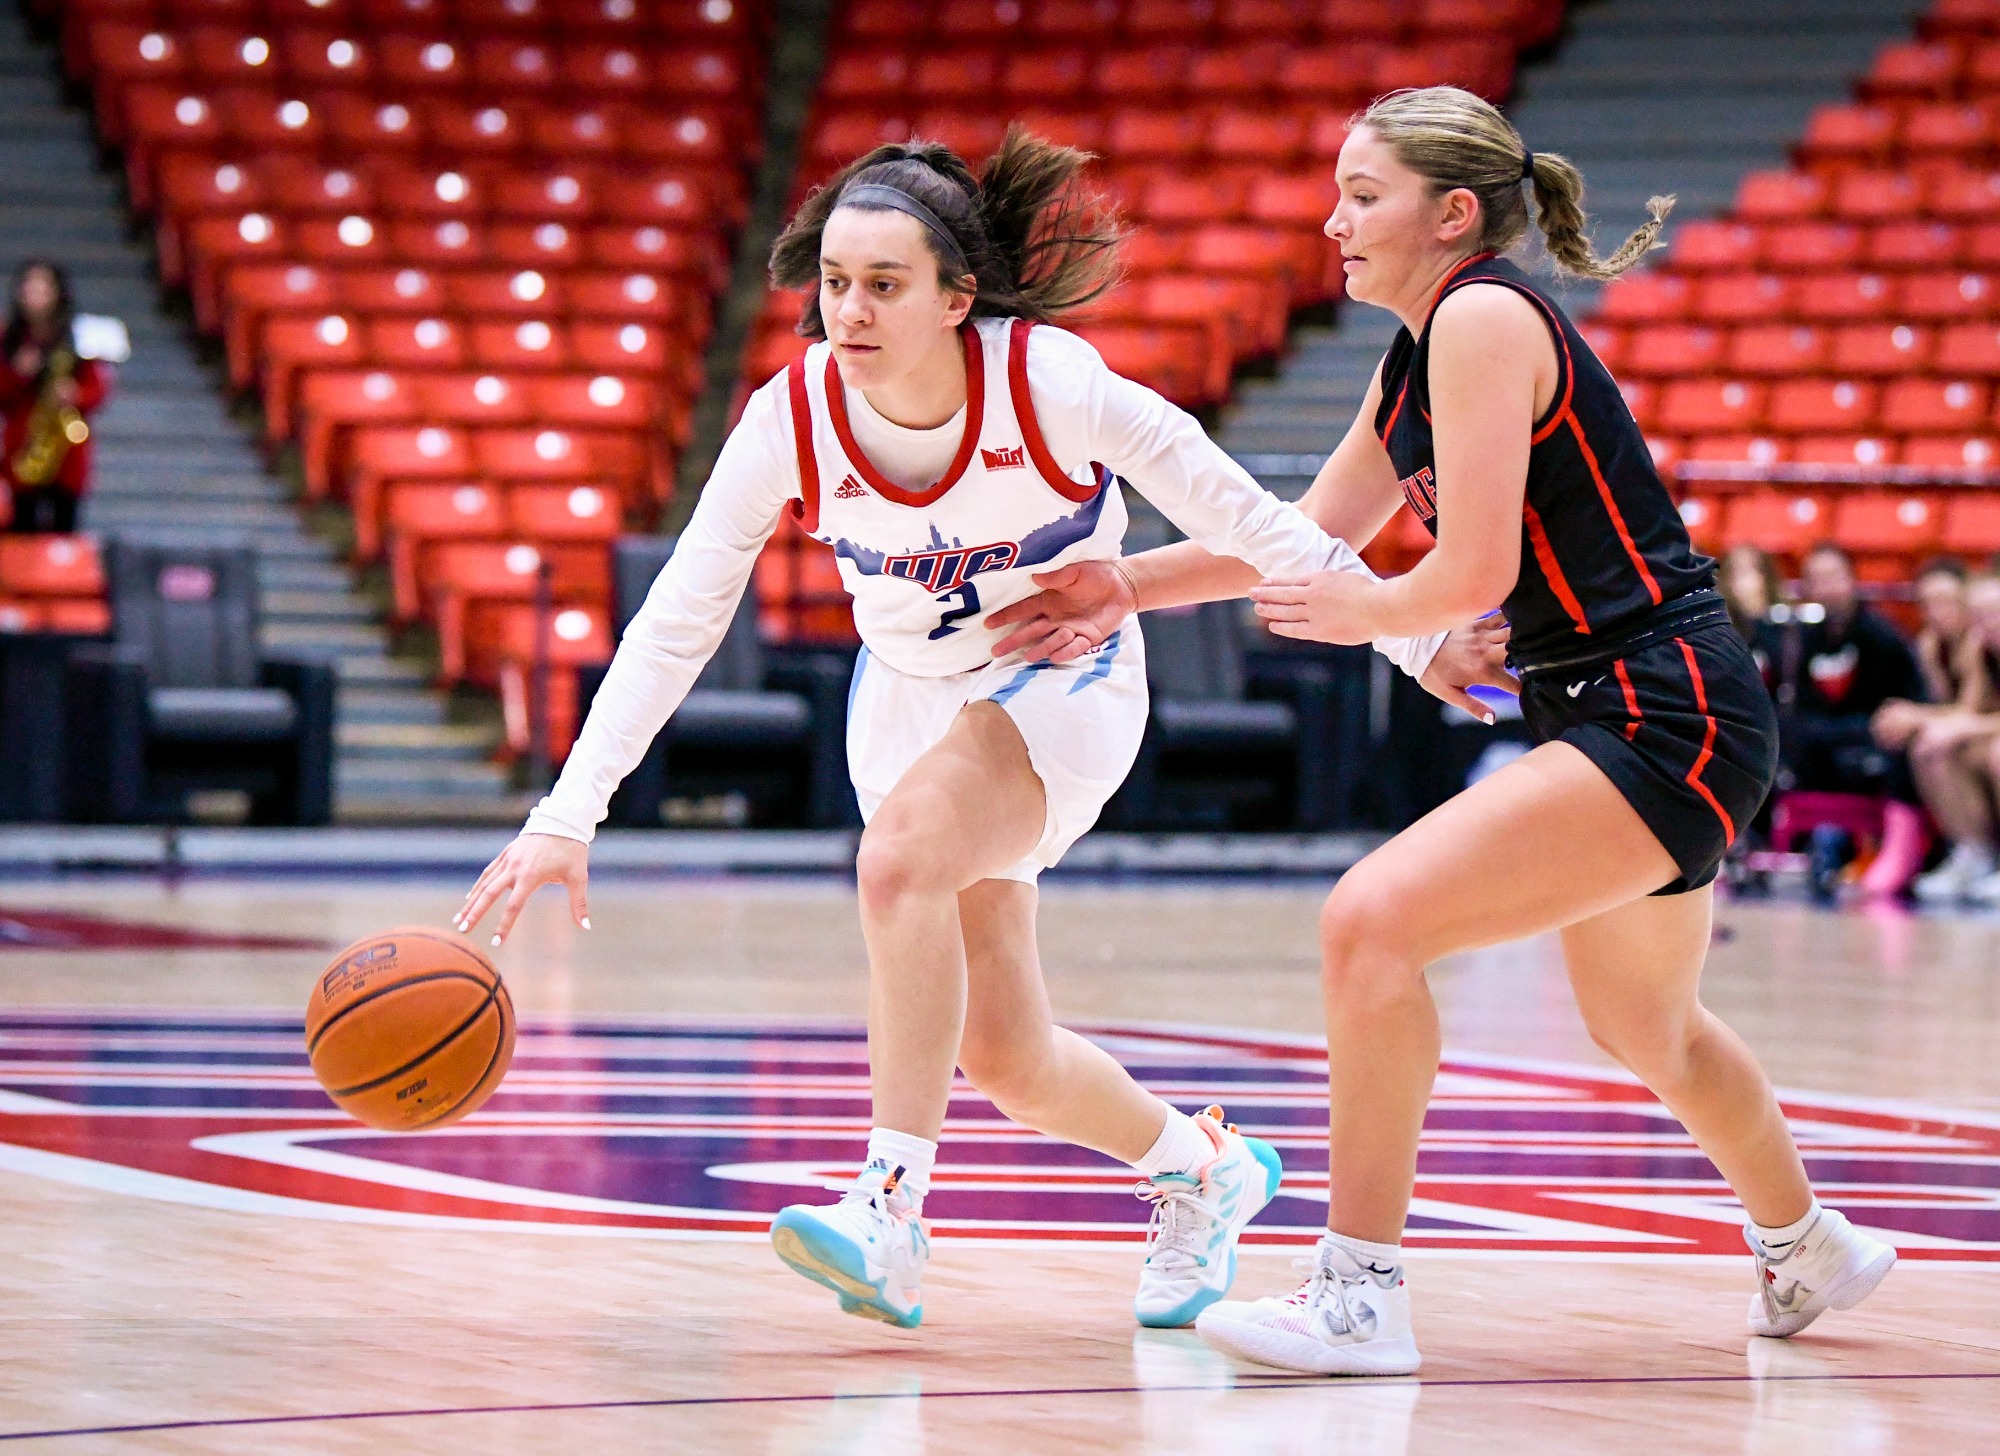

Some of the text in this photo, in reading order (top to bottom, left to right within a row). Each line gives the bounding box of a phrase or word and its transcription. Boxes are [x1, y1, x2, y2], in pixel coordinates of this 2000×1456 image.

[980, 445, 1025, 468] VALLEY
[883, 542, 1019, 593] UIC
[928, 581, 981, 640] 2
